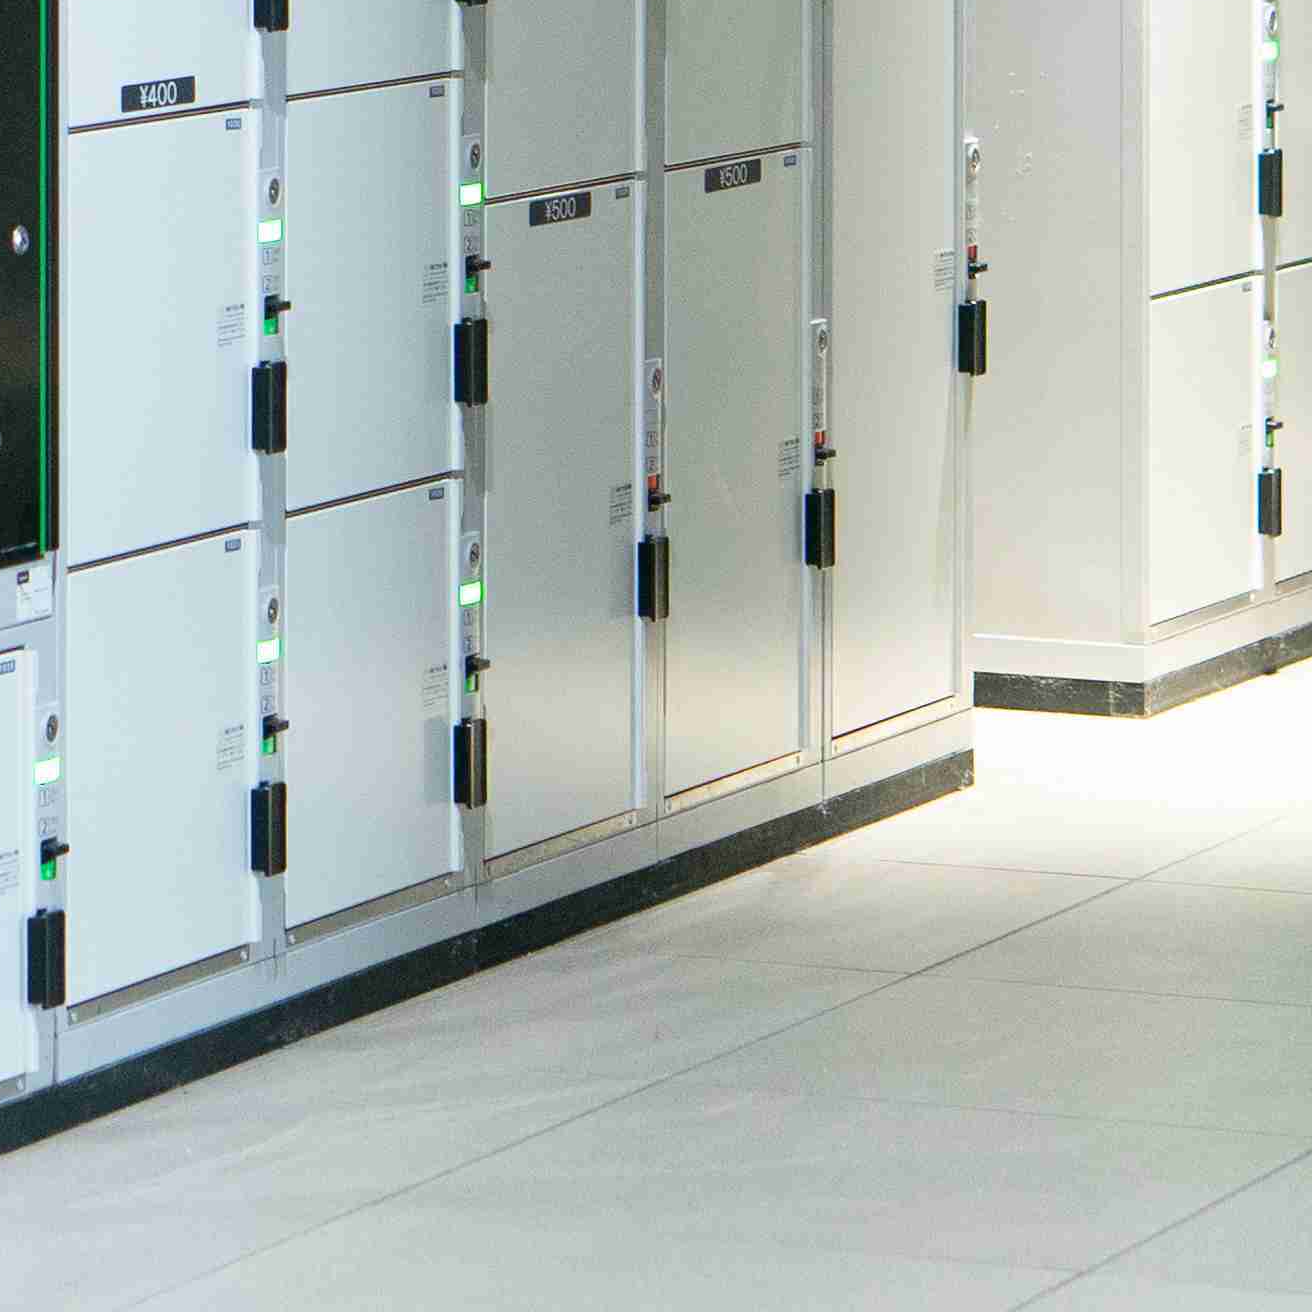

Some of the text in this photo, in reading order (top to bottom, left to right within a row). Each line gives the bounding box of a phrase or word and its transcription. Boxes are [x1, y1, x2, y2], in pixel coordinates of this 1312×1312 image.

[140, 83, 178, 108] ¥400
[720, 163, 747, 186] ¥500
[544, 197, 576, 221] ¥500
